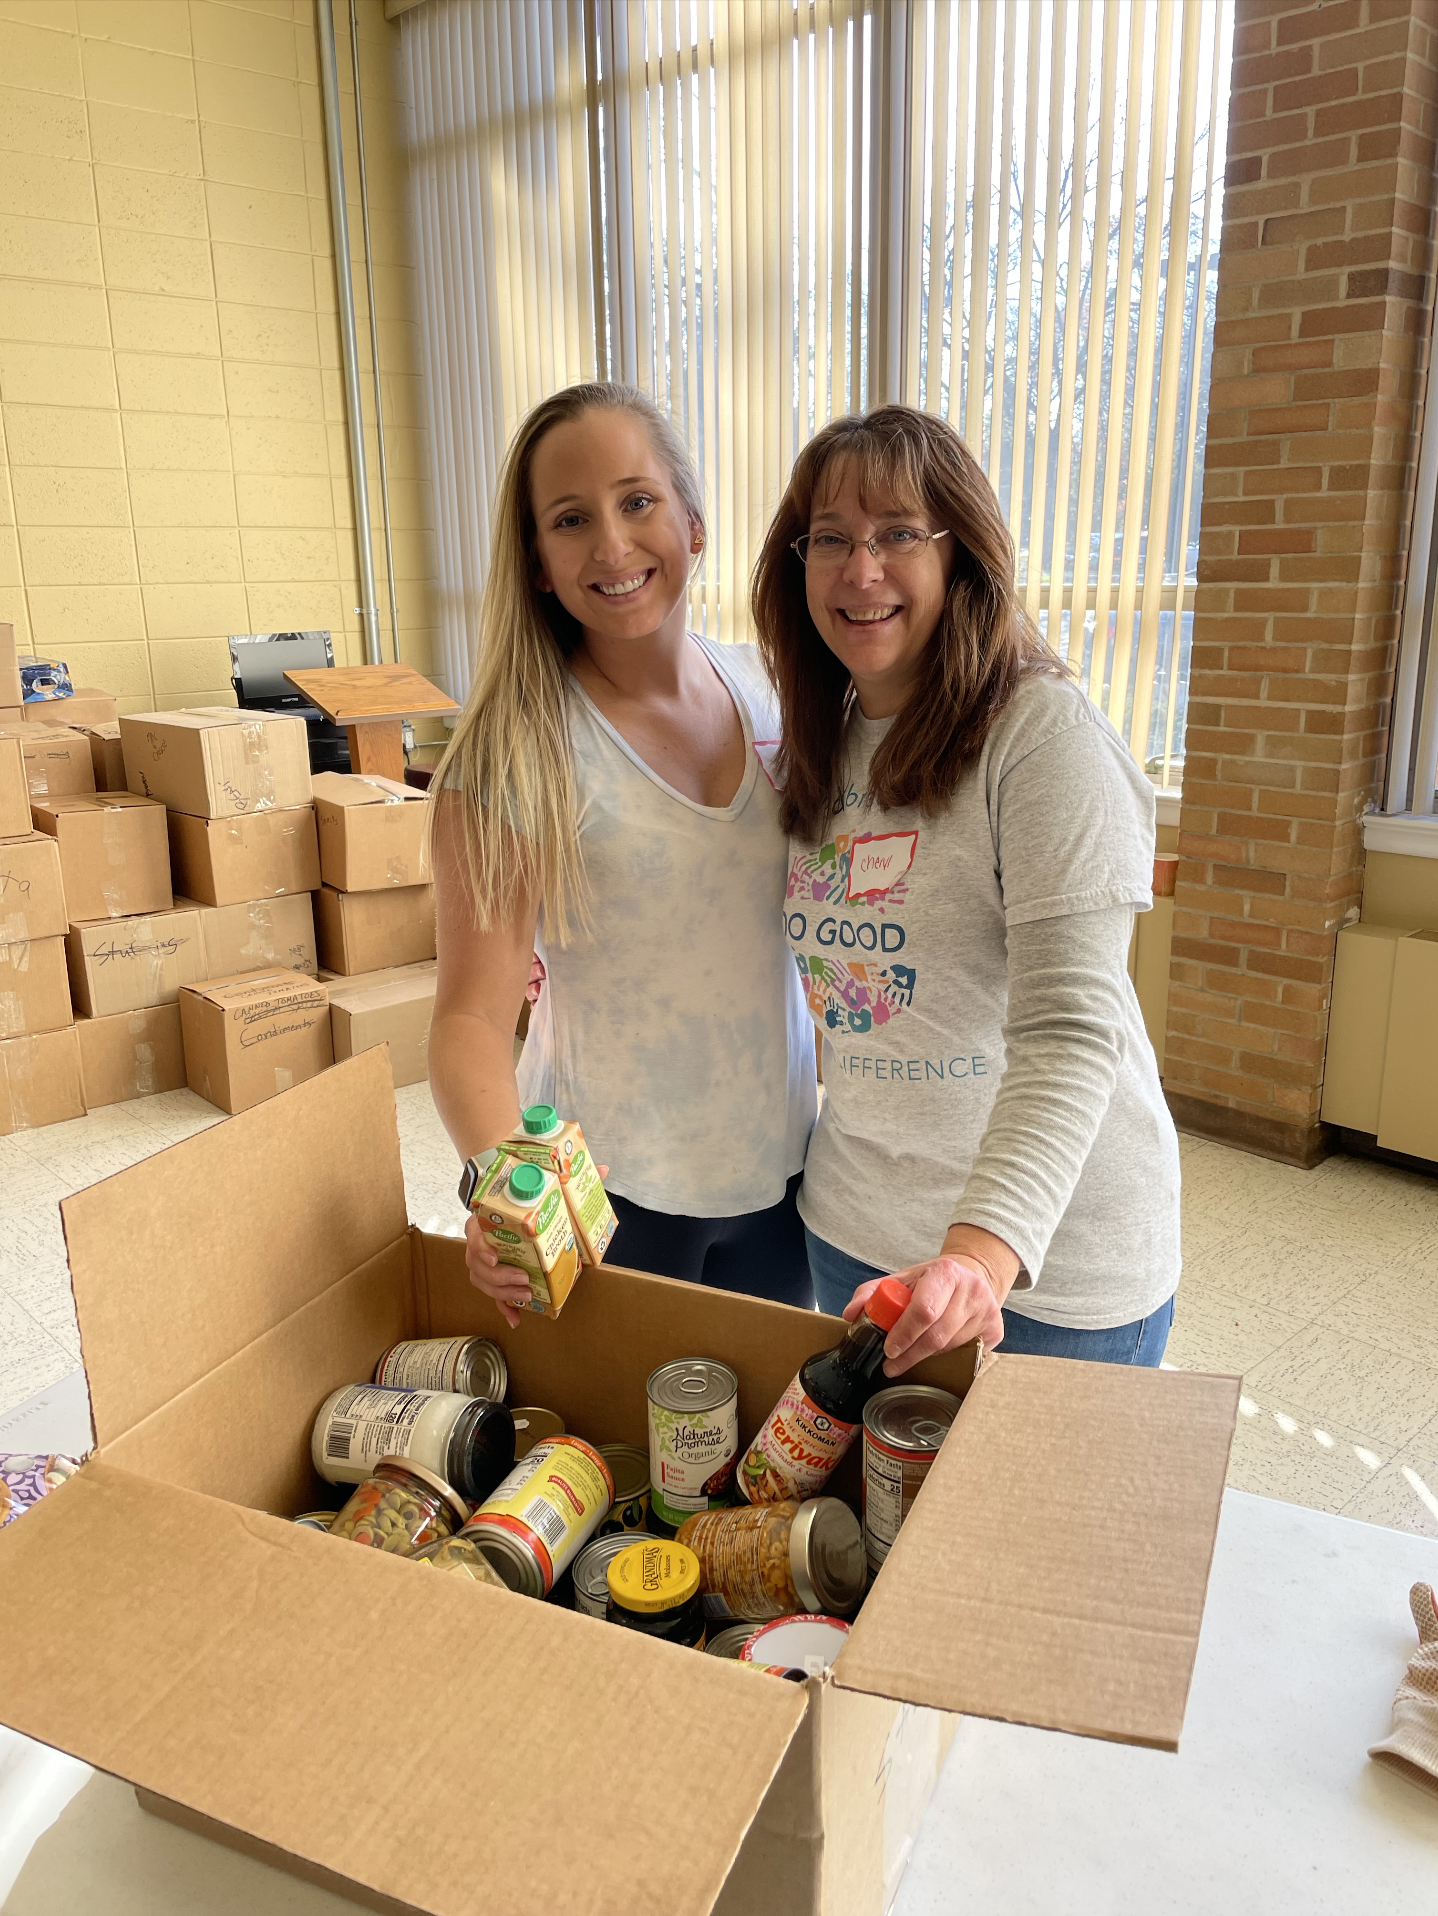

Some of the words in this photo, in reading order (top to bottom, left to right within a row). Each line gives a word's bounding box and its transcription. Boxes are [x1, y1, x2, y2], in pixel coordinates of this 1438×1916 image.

[815, 917, 906, 952] GOOD
[275, 989, 322, 1007] TOMATOES
[239, 1018, 316, 1049] Condiments
[840, 1055, 988, 1081] IFFERENCE
[537, 1193, 559, 1230] Pacific
[493, 1229, 519, 1241] Pacific
[387, 1412, 398, 1424] 120
[675, 1425, 724, 1441] Nature's
[795, 1416, 837, 1447] KIKKOMAN
[671, 1434, 728, 1453] Promise
[570, 1439, 587, 1452] Large
[588, 1450, 602, 1467] Large
[681, 1448, 718, 1461] Organic
[769, 1440, 796, 1469] Marinade
[796, 1465, 803, 1474] &
[666, 1463, 685, 1475] Fajita
[885, 1456, 902, 1471] Facts
[666, 1471, 686, 1483] Sauce
[889, 1483, 901, 1494] 25
